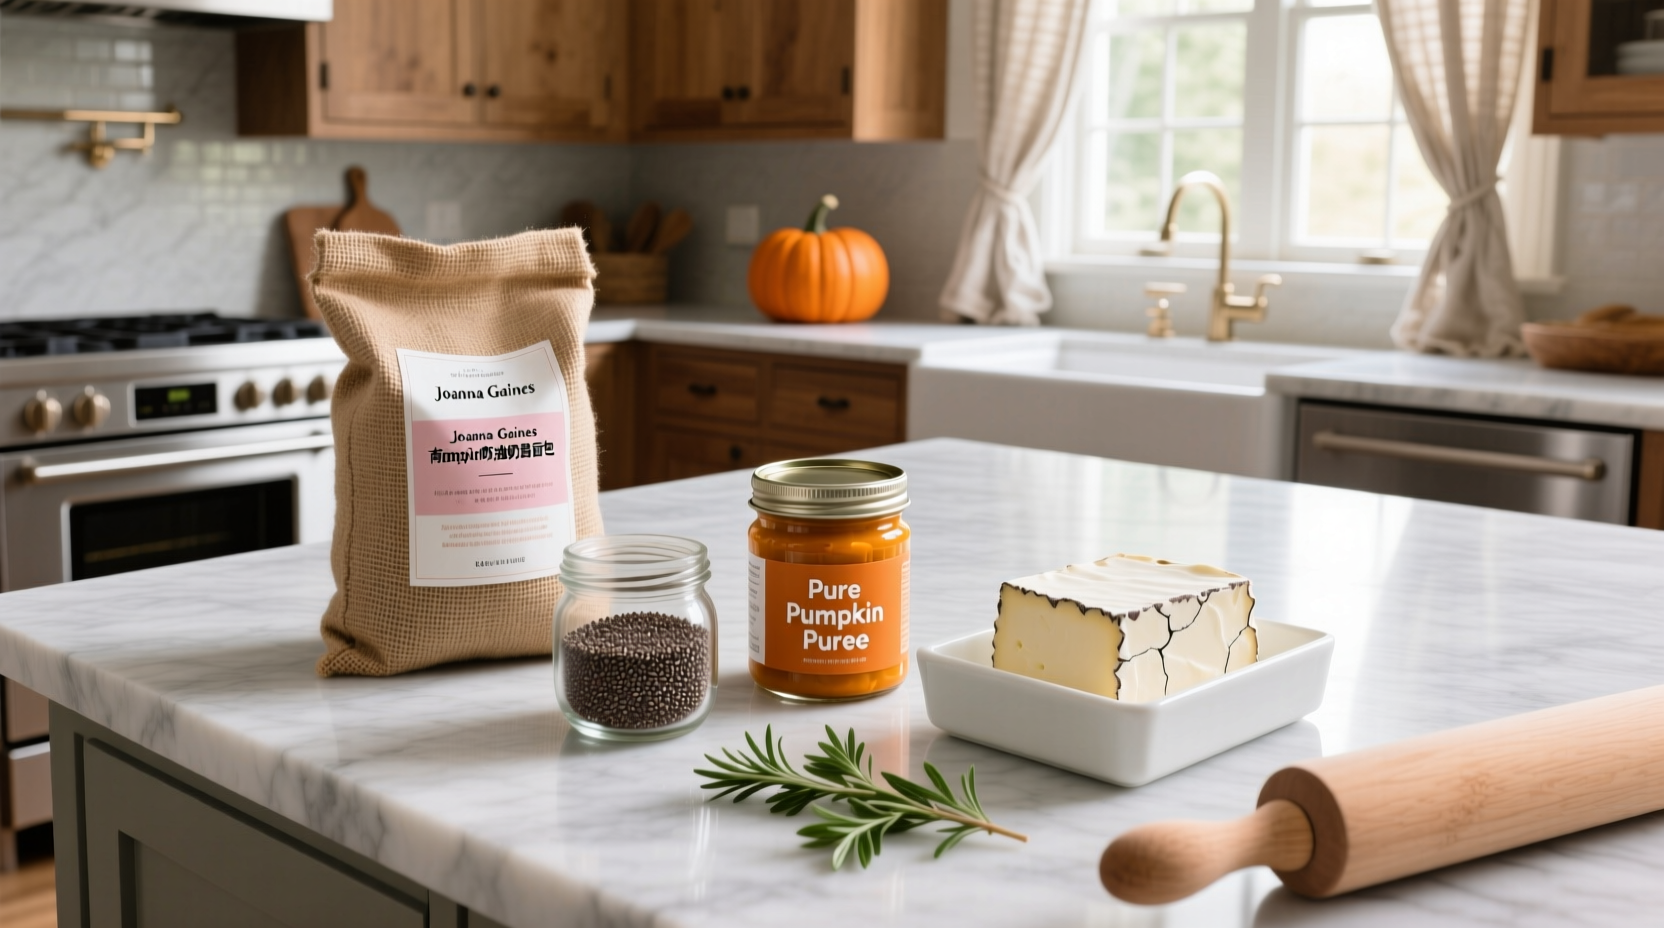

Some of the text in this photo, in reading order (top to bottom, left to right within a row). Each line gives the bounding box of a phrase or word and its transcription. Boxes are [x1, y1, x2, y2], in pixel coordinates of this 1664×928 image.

[435, 383, 536, 402] Joanna Gaines
[449, 427, 538, 444] Joanna Gaines
[808, 578, 861, 600] Pure
[786, 601, 884, 631] Pumpkin
[803, 629, 870, 651] Puree
